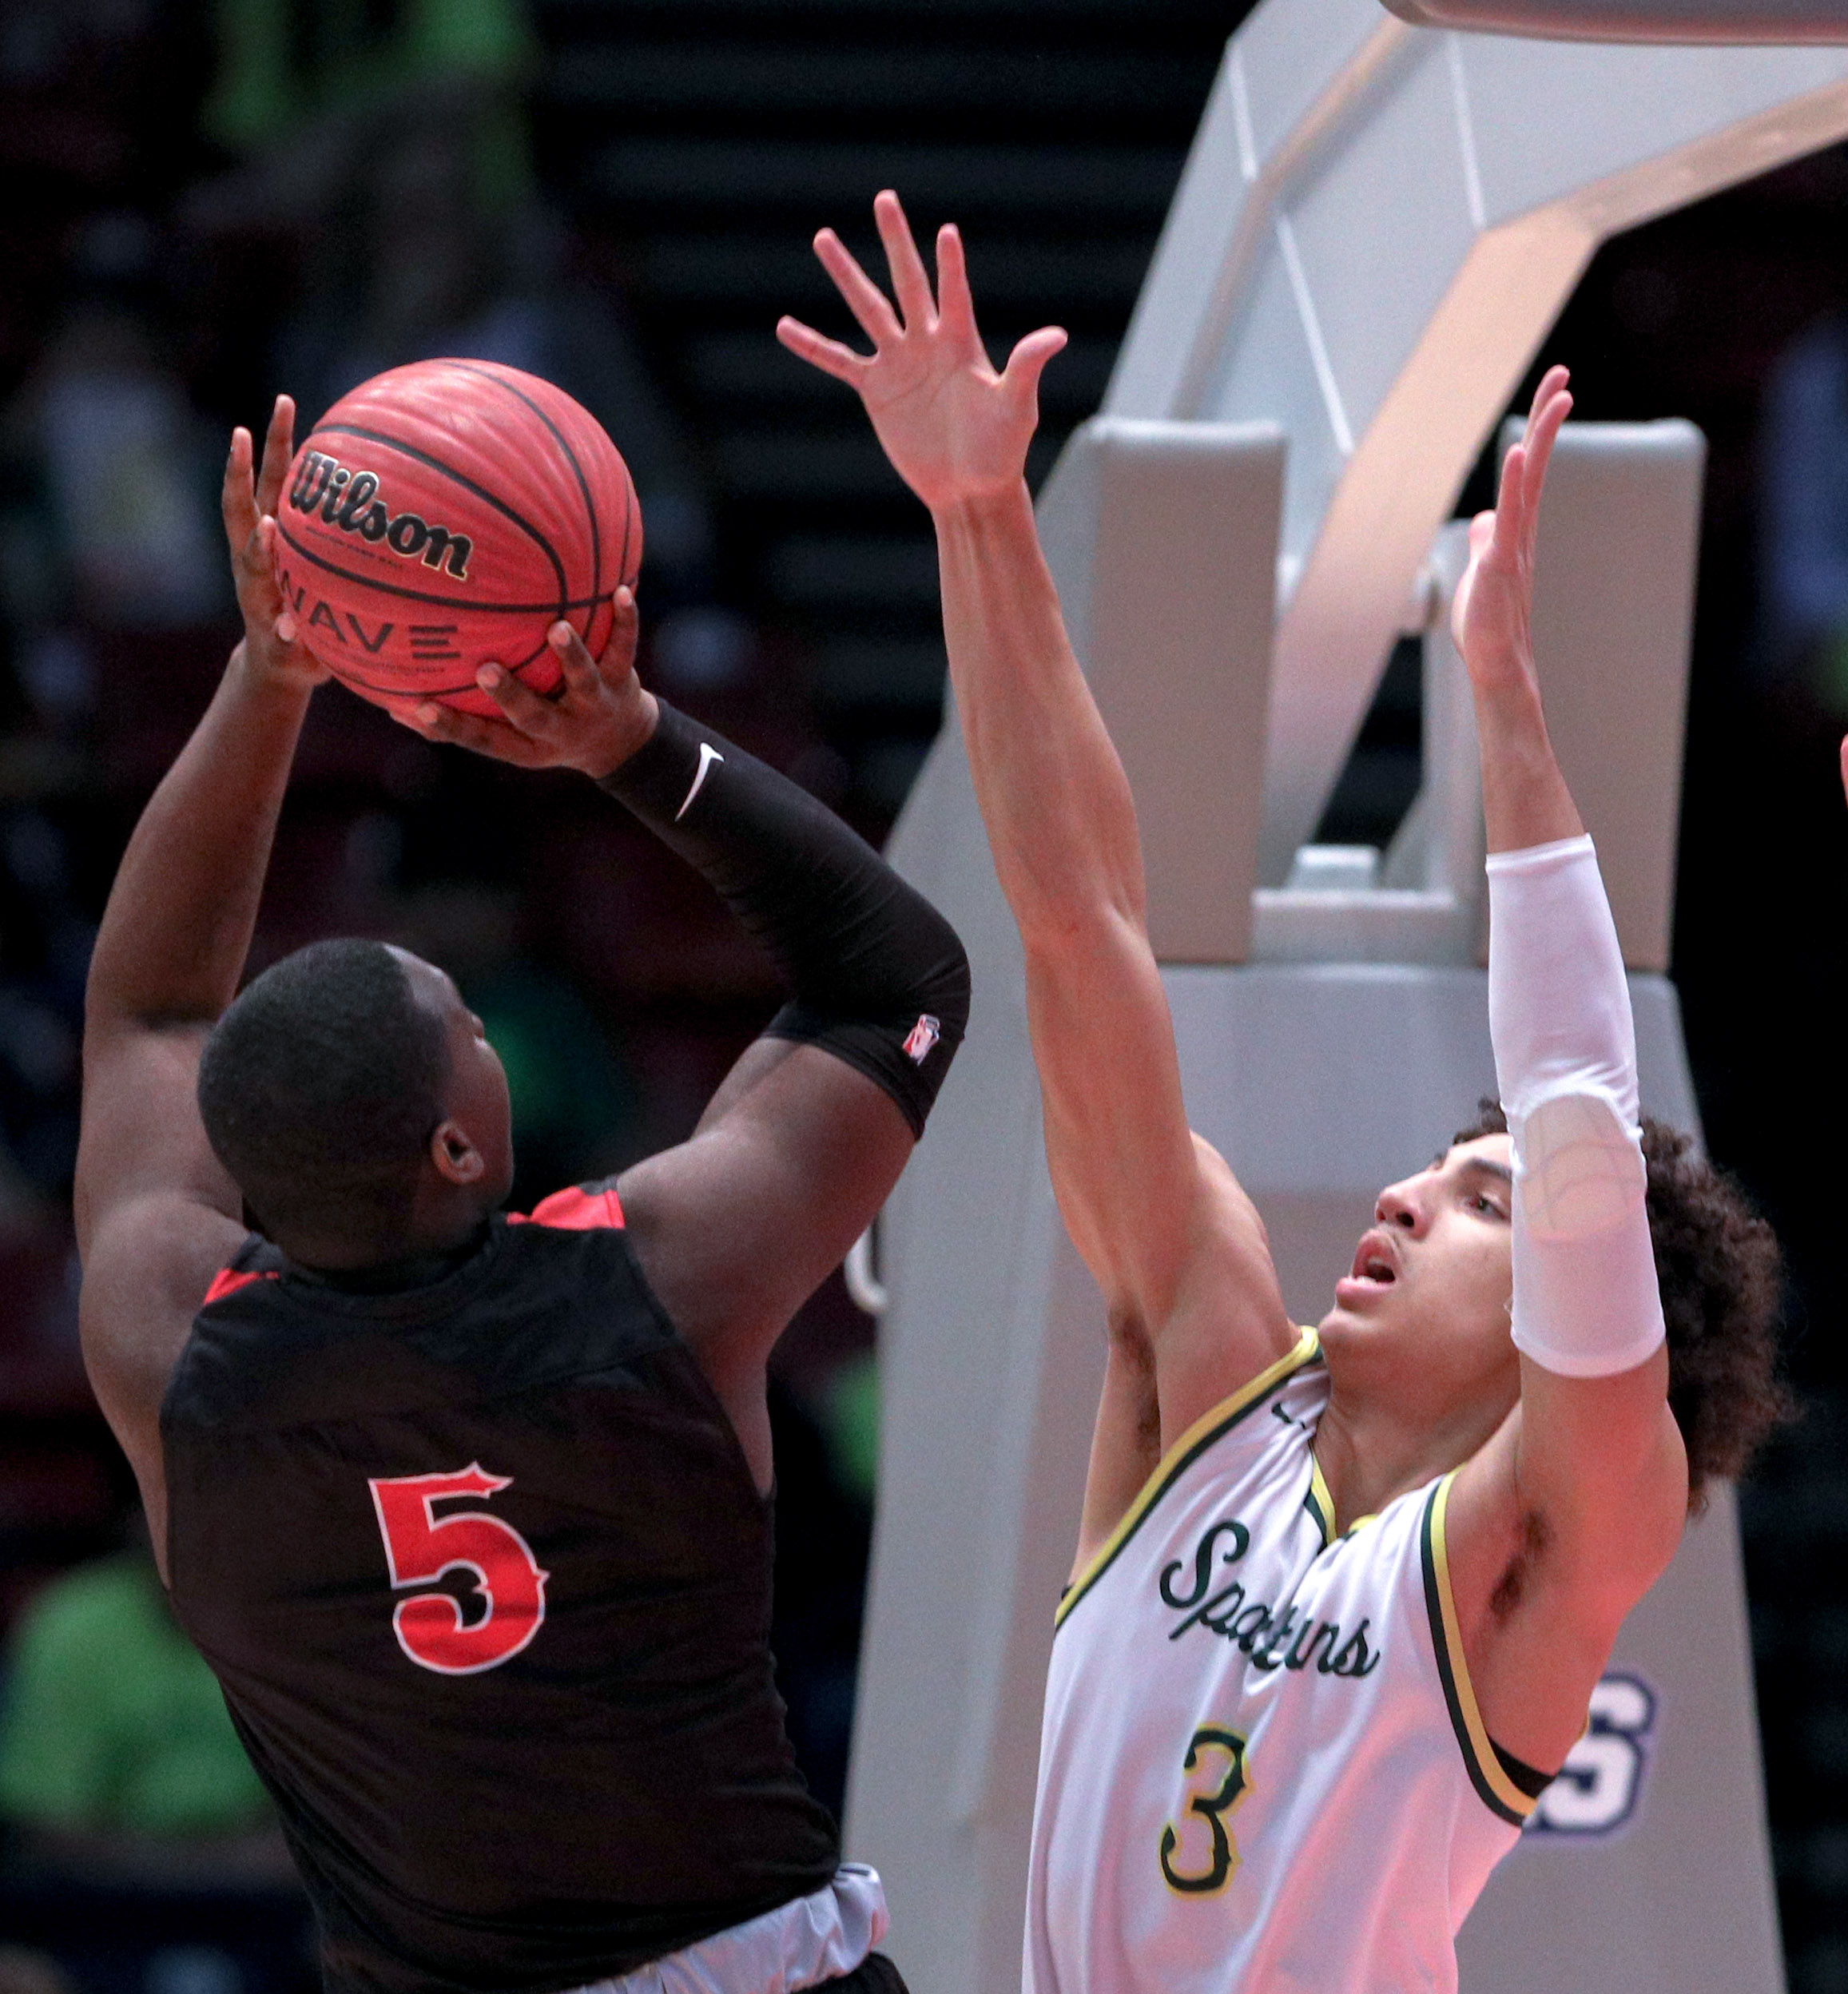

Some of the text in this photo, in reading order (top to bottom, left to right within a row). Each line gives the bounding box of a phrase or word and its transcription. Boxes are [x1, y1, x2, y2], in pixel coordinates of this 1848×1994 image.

[288, 451, 472, 582] Wilson
[368, 1460, 550, 1675] 5
[1159, 1521, 1380, 1677] Spatns
[1158, 1722, 1254, 1899] 3
